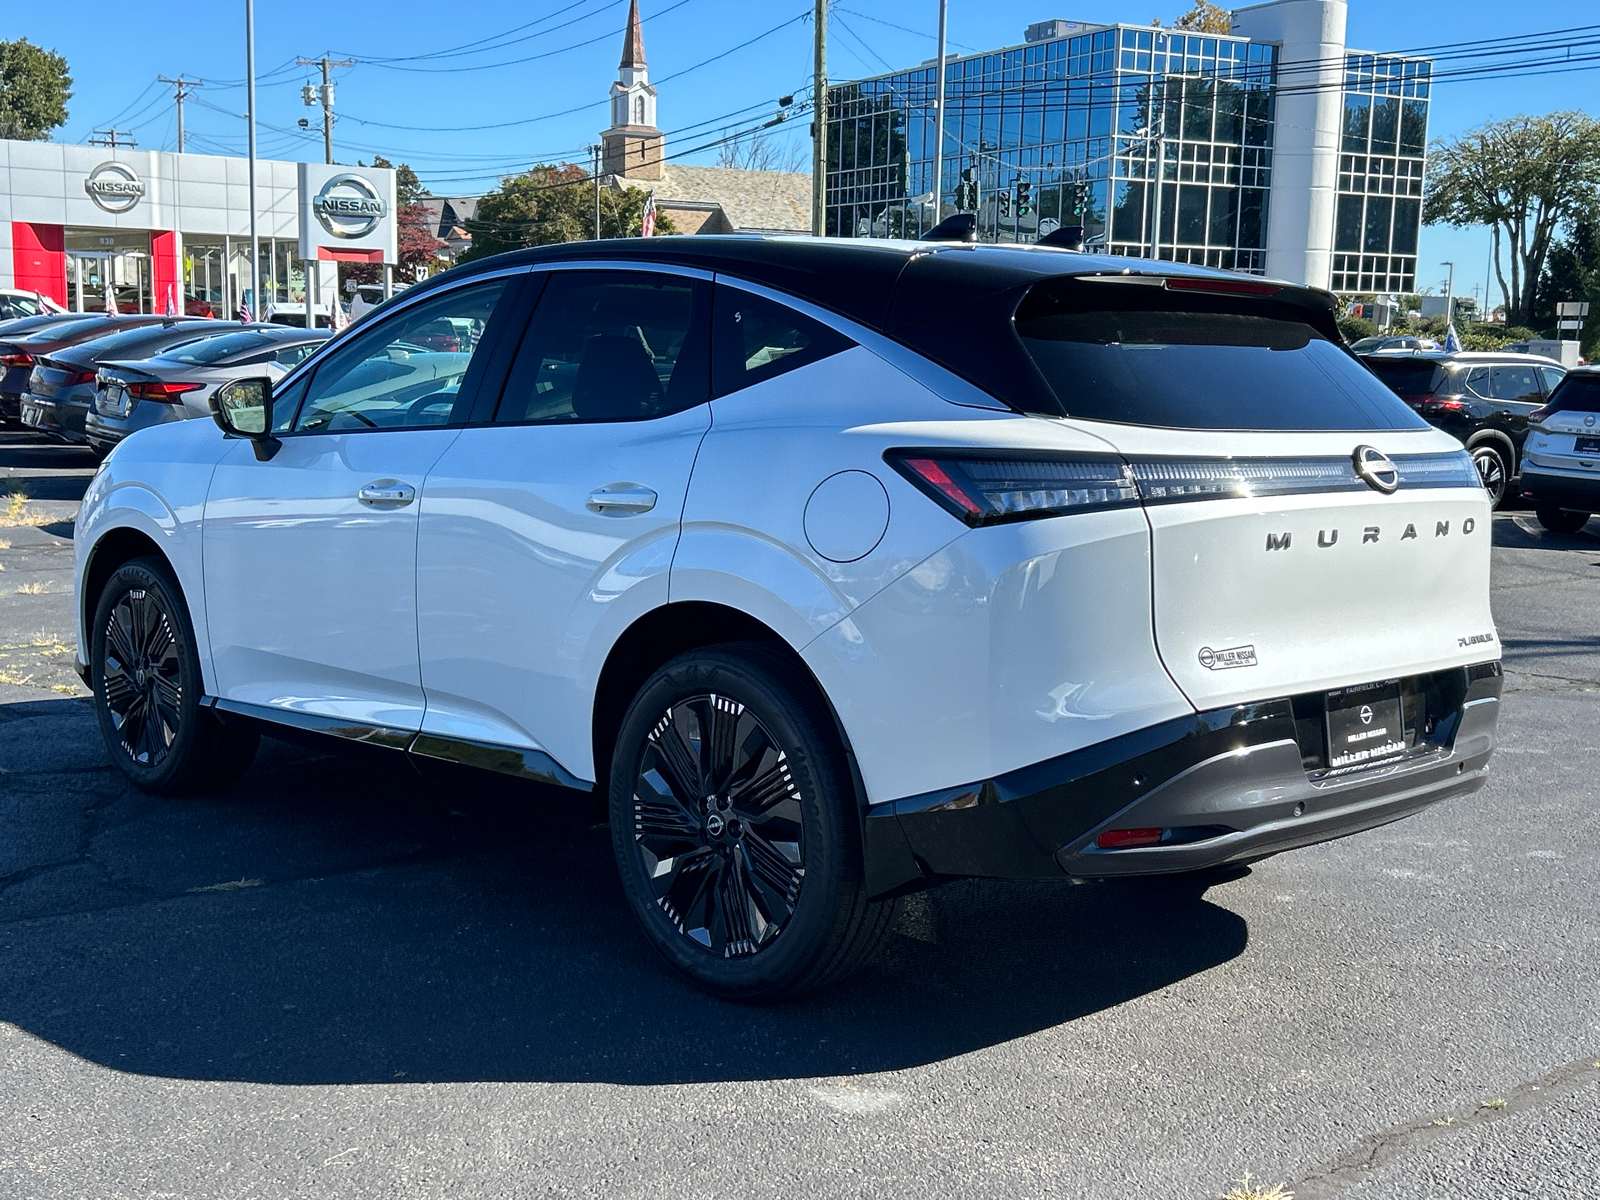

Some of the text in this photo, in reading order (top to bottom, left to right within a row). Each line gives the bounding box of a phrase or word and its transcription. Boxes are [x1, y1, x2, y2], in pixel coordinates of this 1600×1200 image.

[91, 181, 140, 193] NISSAN
[321, 199, 381, 213] NISSAN
[1265, 517, 1476, 552] MURANO
[1215, 650, 1255, 662] MILLER NISSAN
[1348, 727, 1387, 742] MILLER NISSAN
[1332, 741, 1406, 767] MILLER NISSAN
